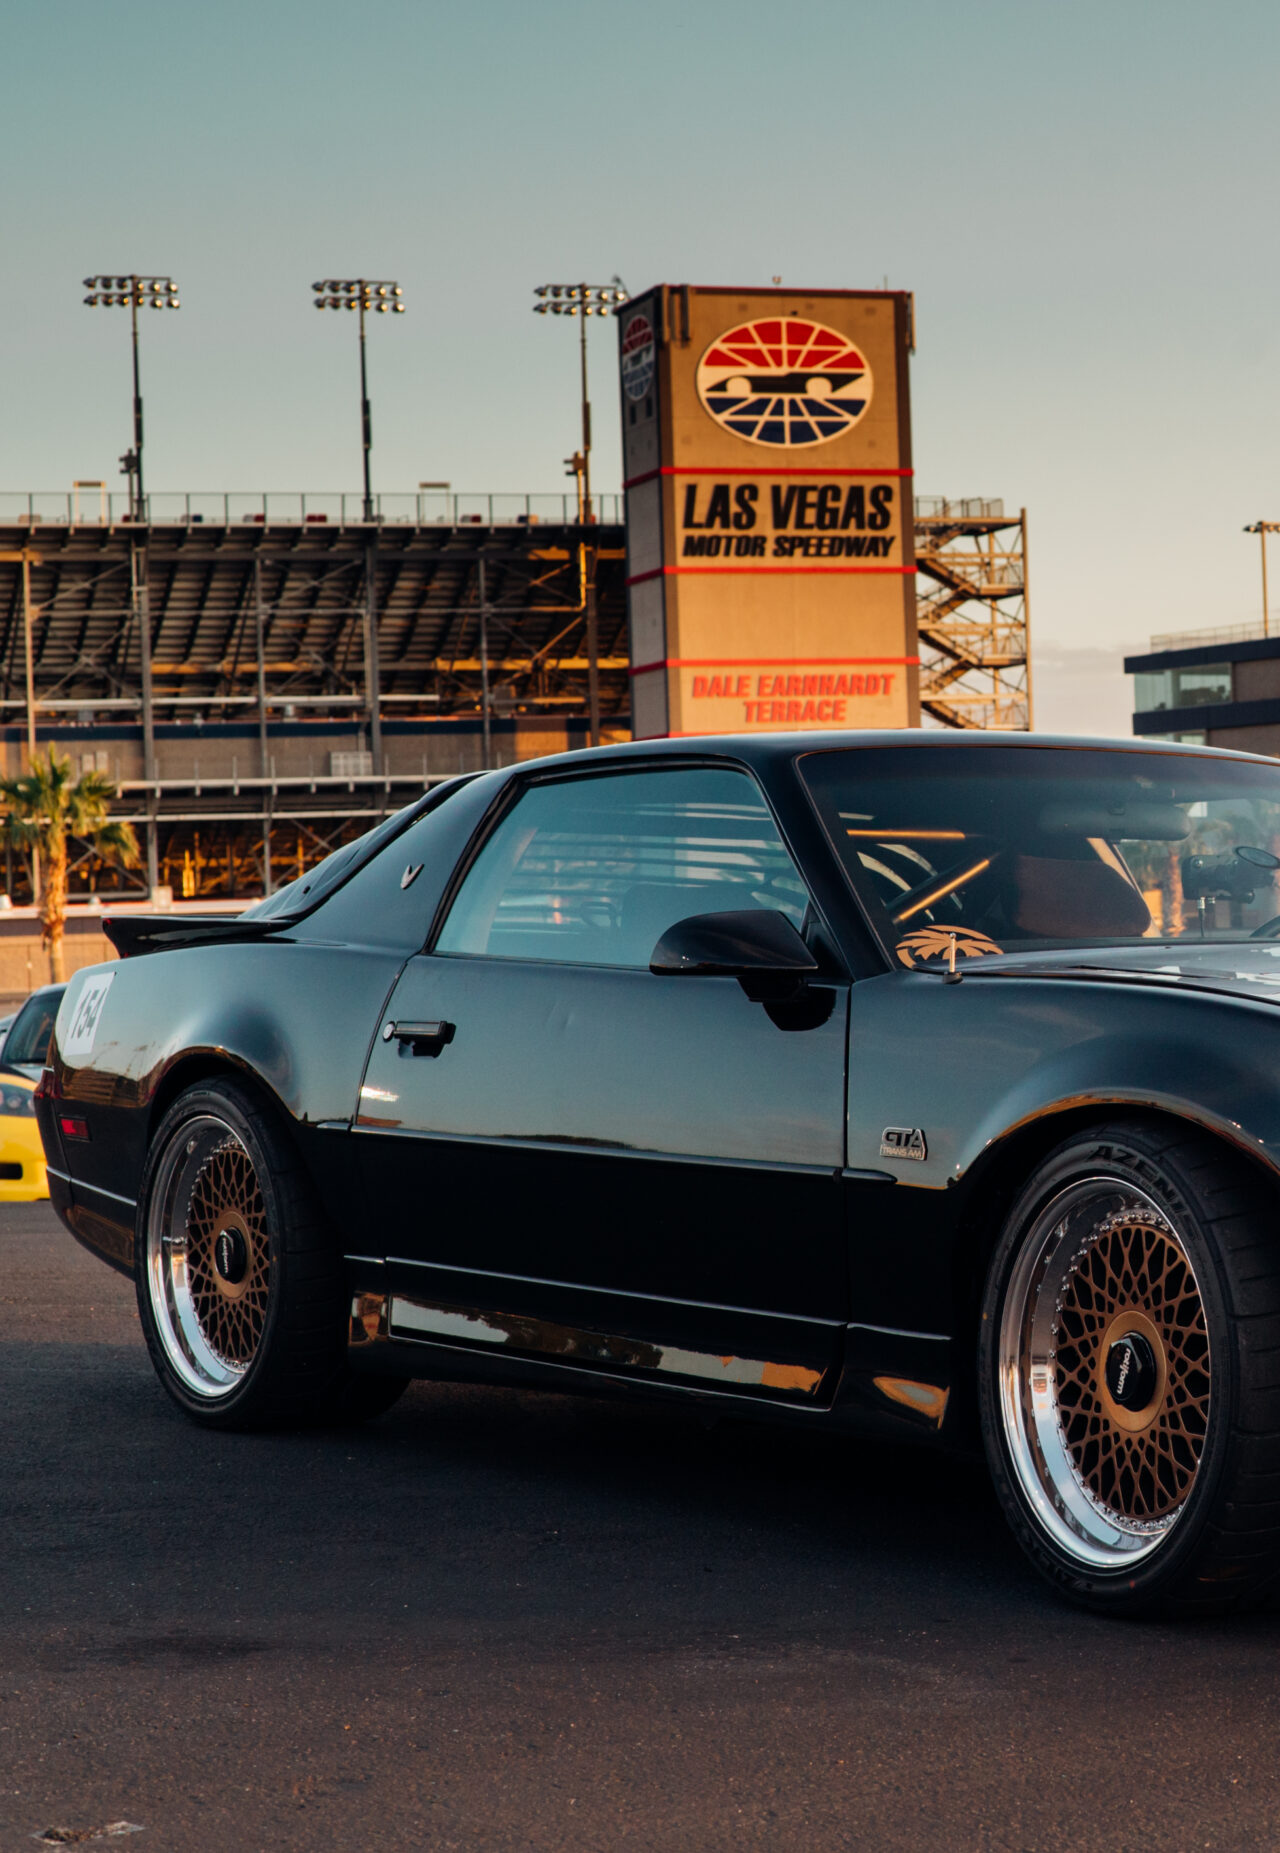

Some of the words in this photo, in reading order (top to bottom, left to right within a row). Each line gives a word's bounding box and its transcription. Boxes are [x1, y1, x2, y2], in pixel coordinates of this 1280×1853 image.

[683, 484, 759, 530] LAS
[771, 484, 893, 530] VEGAS
[682, 535, 767, 557] MOTOR
[772, 535, 896, 557] SPEEDWAY
[692, 675, 751, 698] DALE
[757, 673, 895, 697] EARNHARDT
[743, 699, 848, 723] TERRACE
[882, 1126, 925, 1148] GTA
[882, 1146, 908, 1157] TRANS
[908, 1149, 922, 1159] AM
[1087, 1145, 1202, 1241] AZENIS
[1116, 1347, 1131, 1395] rotiform
